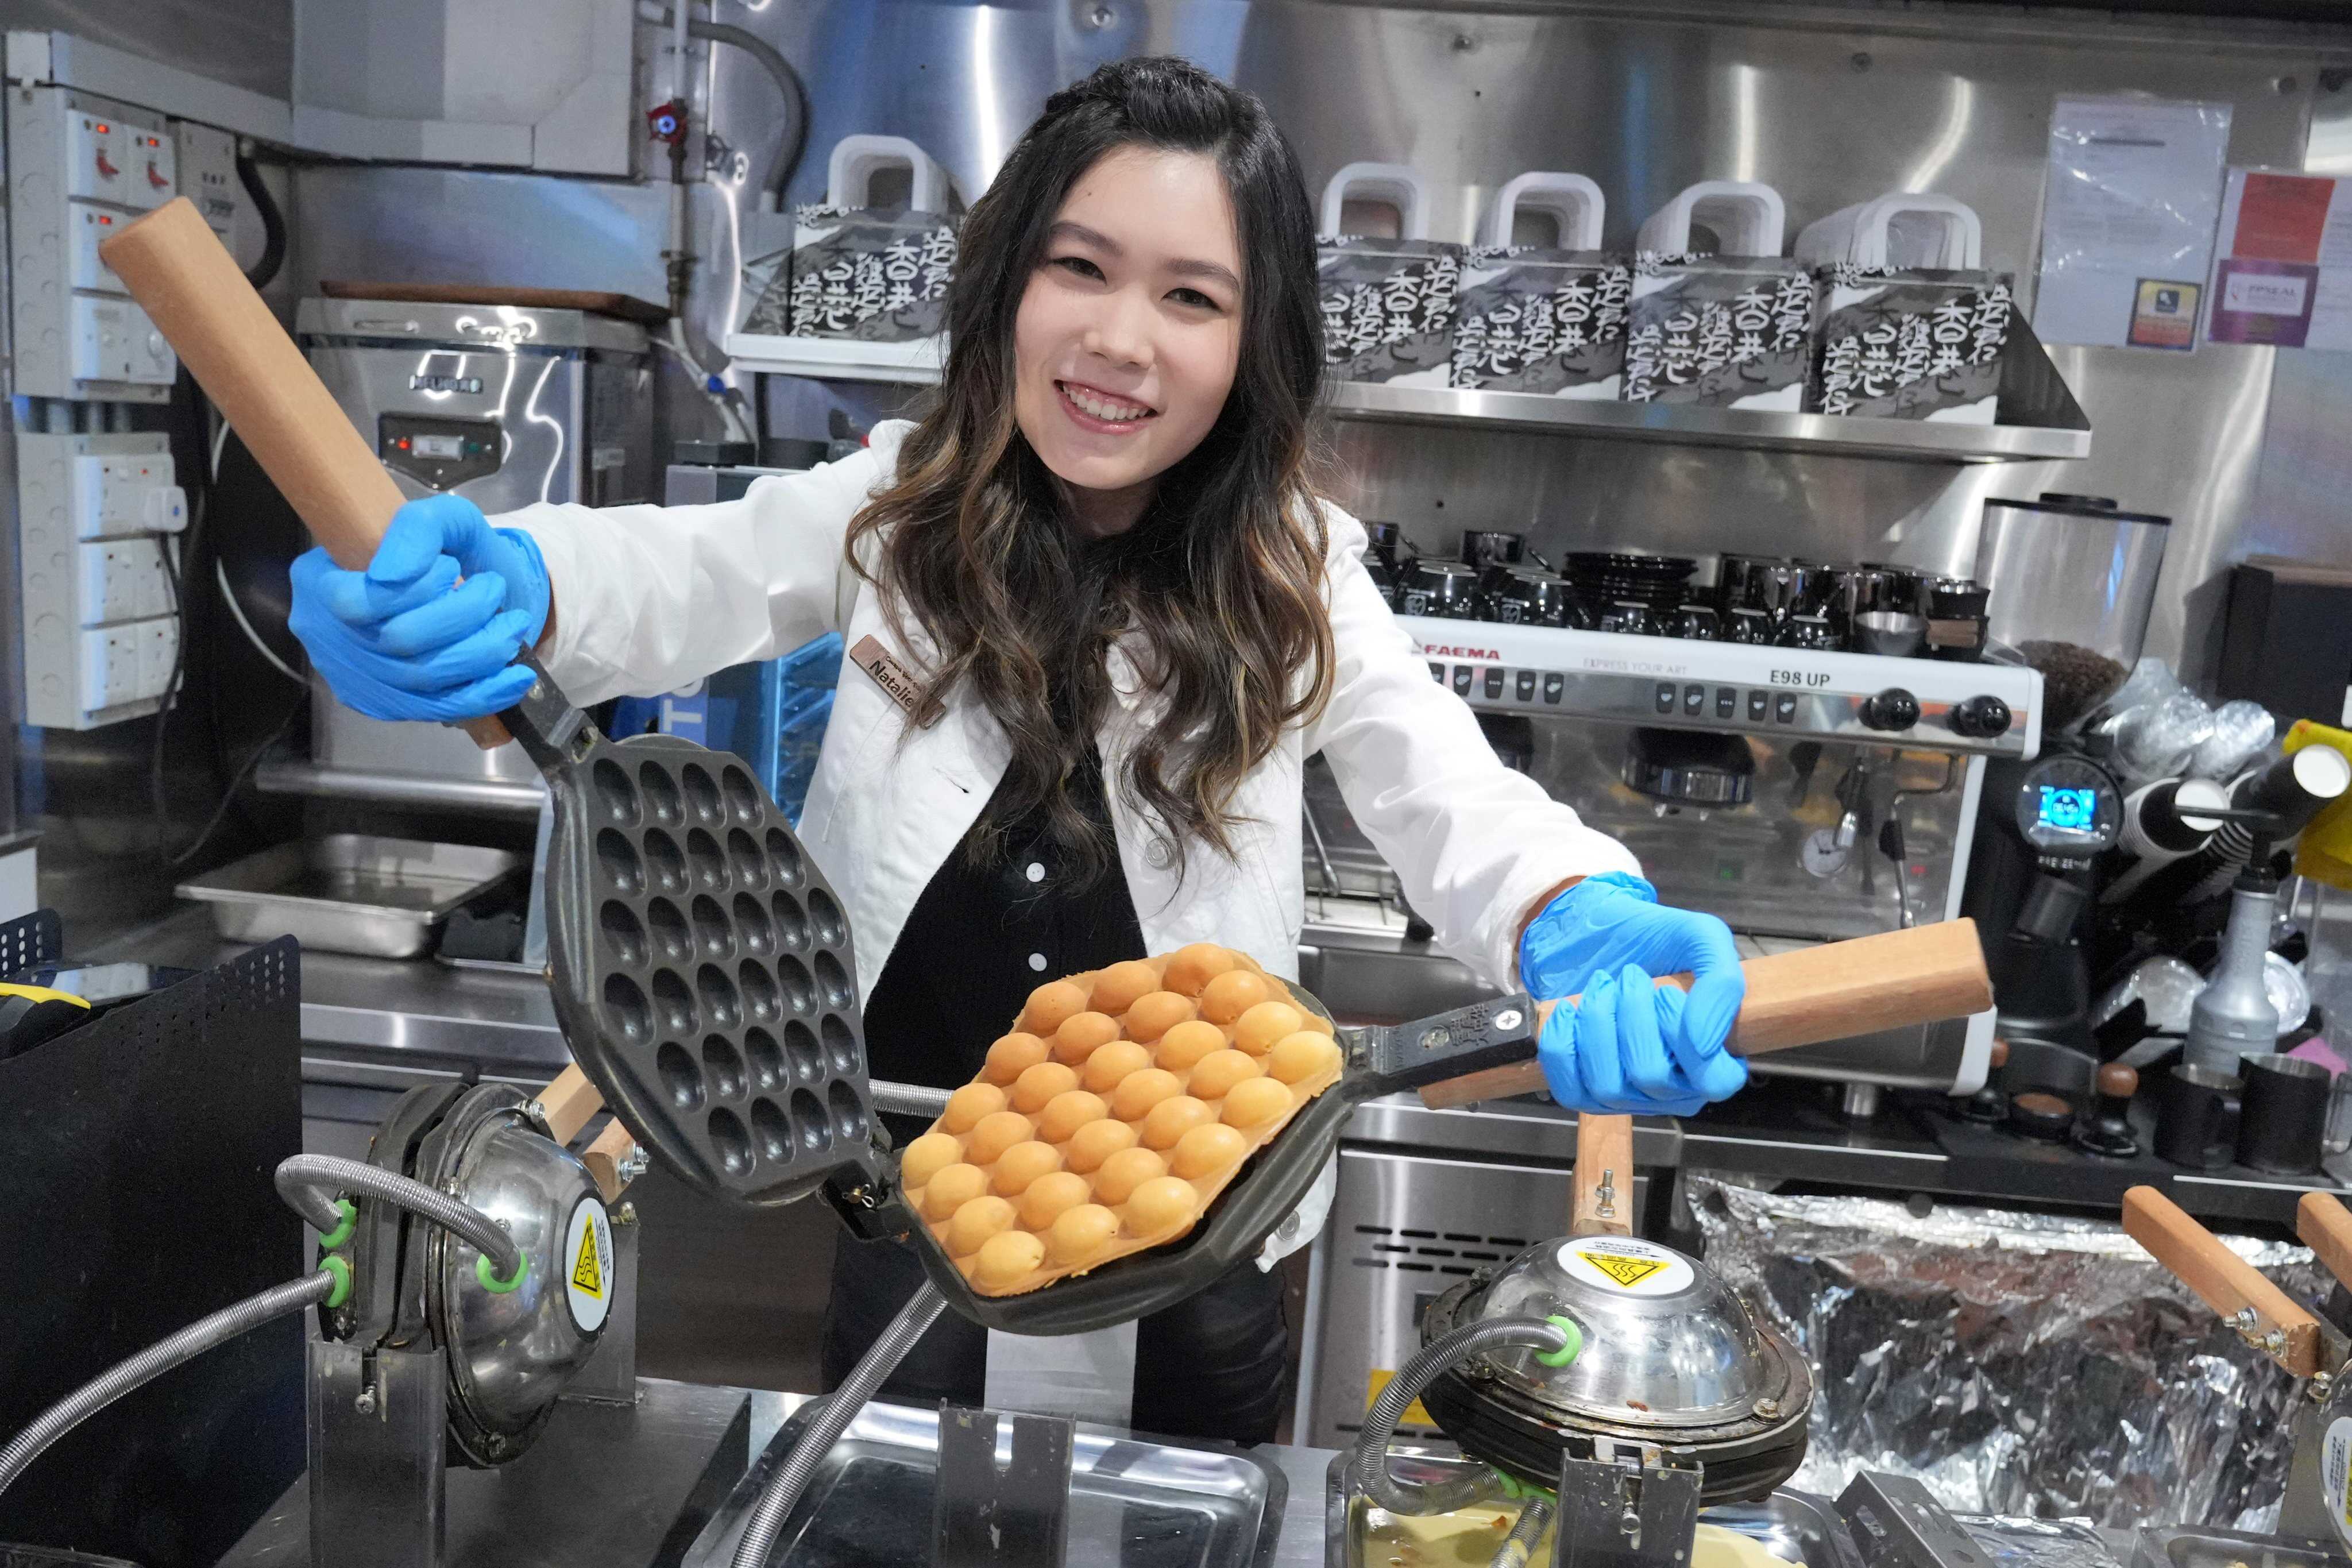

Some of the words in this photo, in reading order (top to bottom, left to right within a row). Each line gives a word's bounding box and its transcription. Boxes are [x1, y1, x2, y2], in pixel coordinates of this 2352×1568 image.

[1424, 644, 1500, 660] FAEMA
[1631, 661, 1663, 673] YOUR
[1666, 663, 1687, 675] ART
[868, 660, 914, 708] Natalie
[1770, 670, 1802, 685] E98
[1807, 673, 1830, 687] UP
